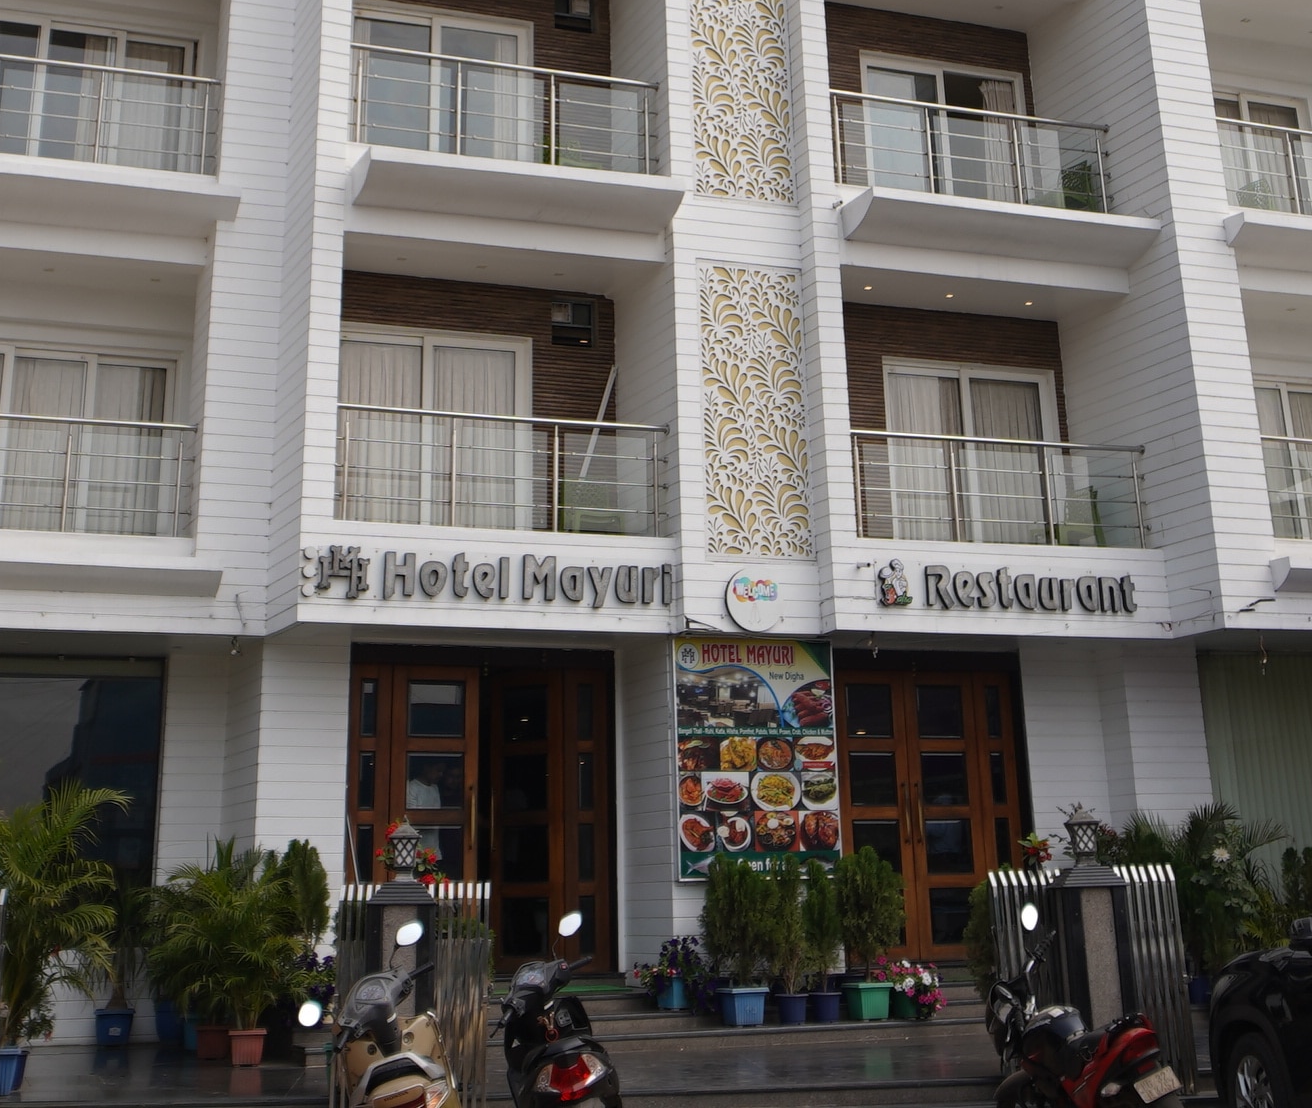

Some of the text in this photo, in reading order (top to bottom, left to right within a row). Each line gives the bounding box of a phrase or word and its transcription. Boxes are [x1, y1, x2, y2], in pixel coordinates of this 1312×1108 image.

[383, 550, 509, 601] Hotel
[521, 554, 672, 608] Mayuri
[924, 564, 1138, 614] Restaurant
[735, 582, 775, 599] WELCOME
[701, 644, 742, 665] HOTEL
[746, 644, 795, 666] MAYURI
[769, 671, 805, 683] New Digha
